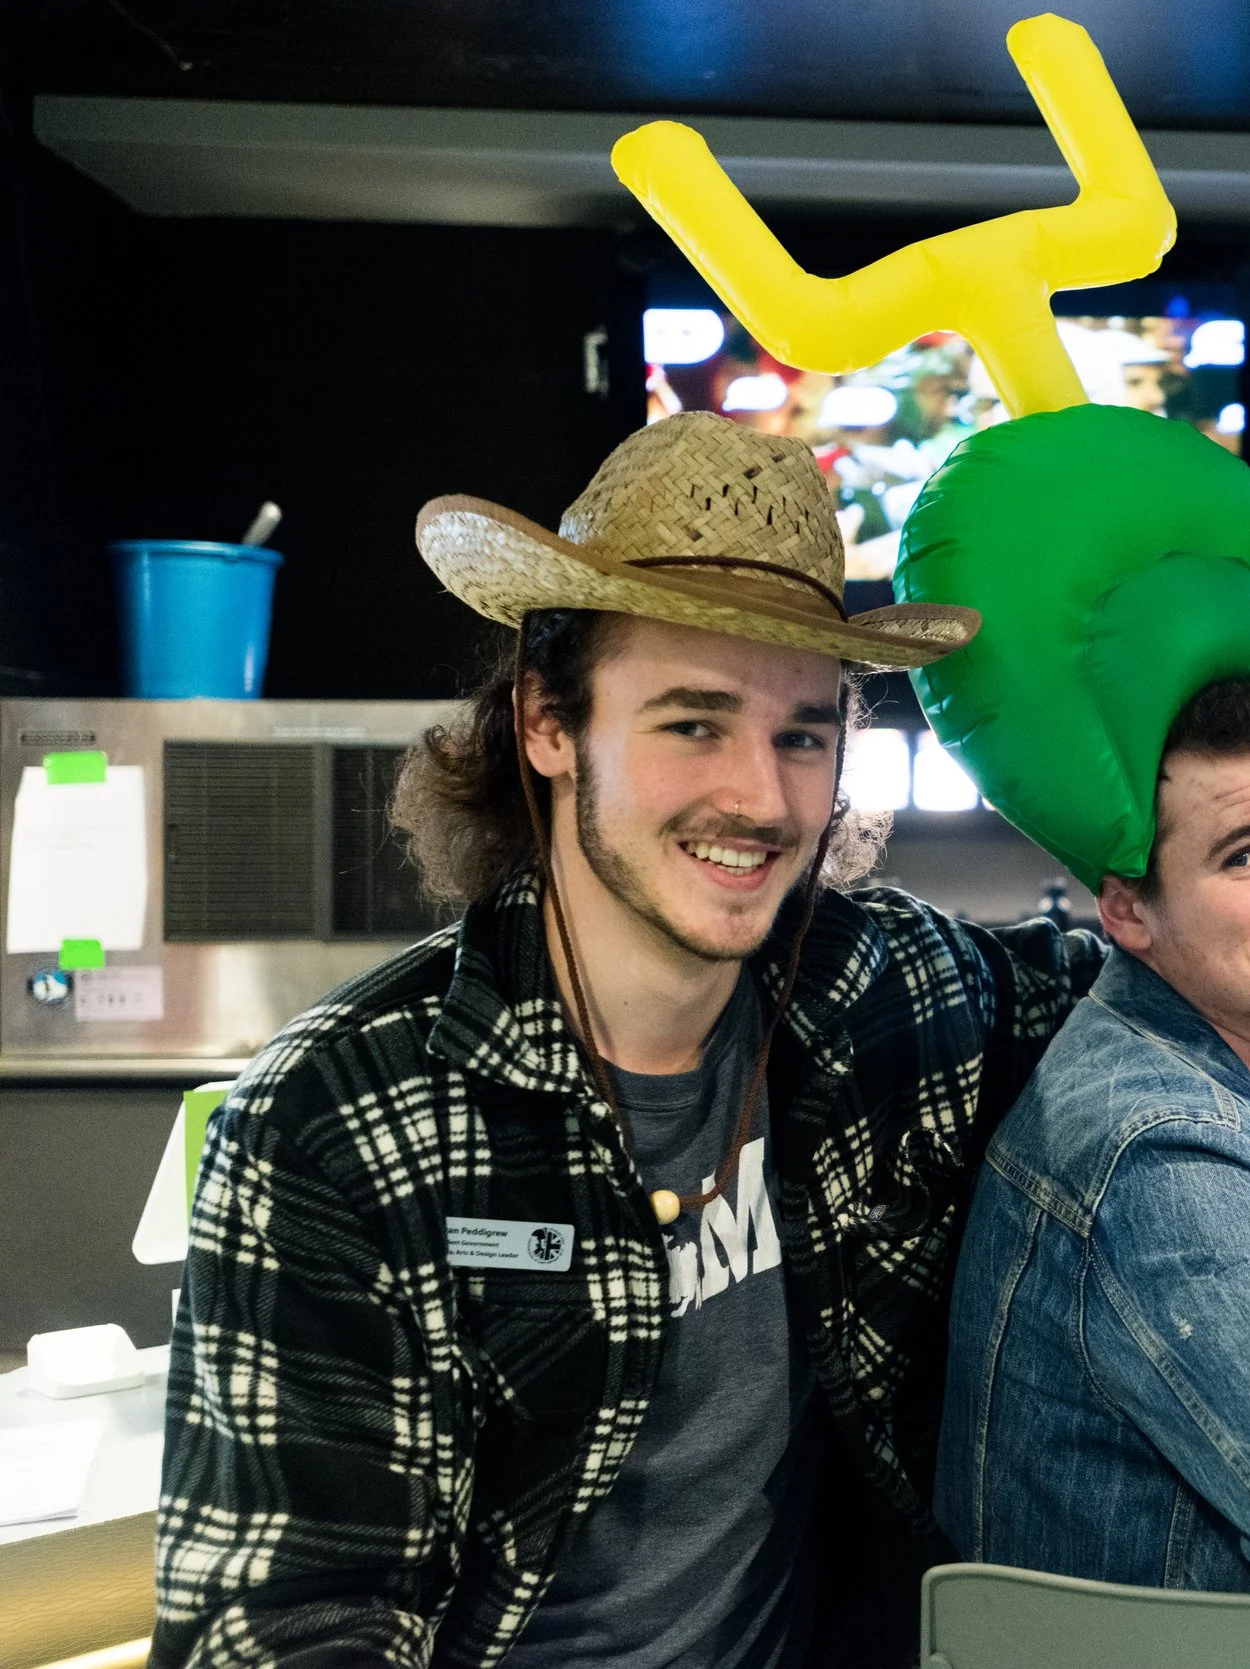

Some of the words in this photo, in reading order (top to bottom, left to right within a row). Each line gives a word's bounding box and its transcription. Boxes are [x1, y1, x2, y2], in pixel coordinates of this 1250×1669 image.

[461, 1227, 508, 1238] Peddigrew
[461, 1240, 499, 1248] Government
[476, 1250, 497, 1258] Design
